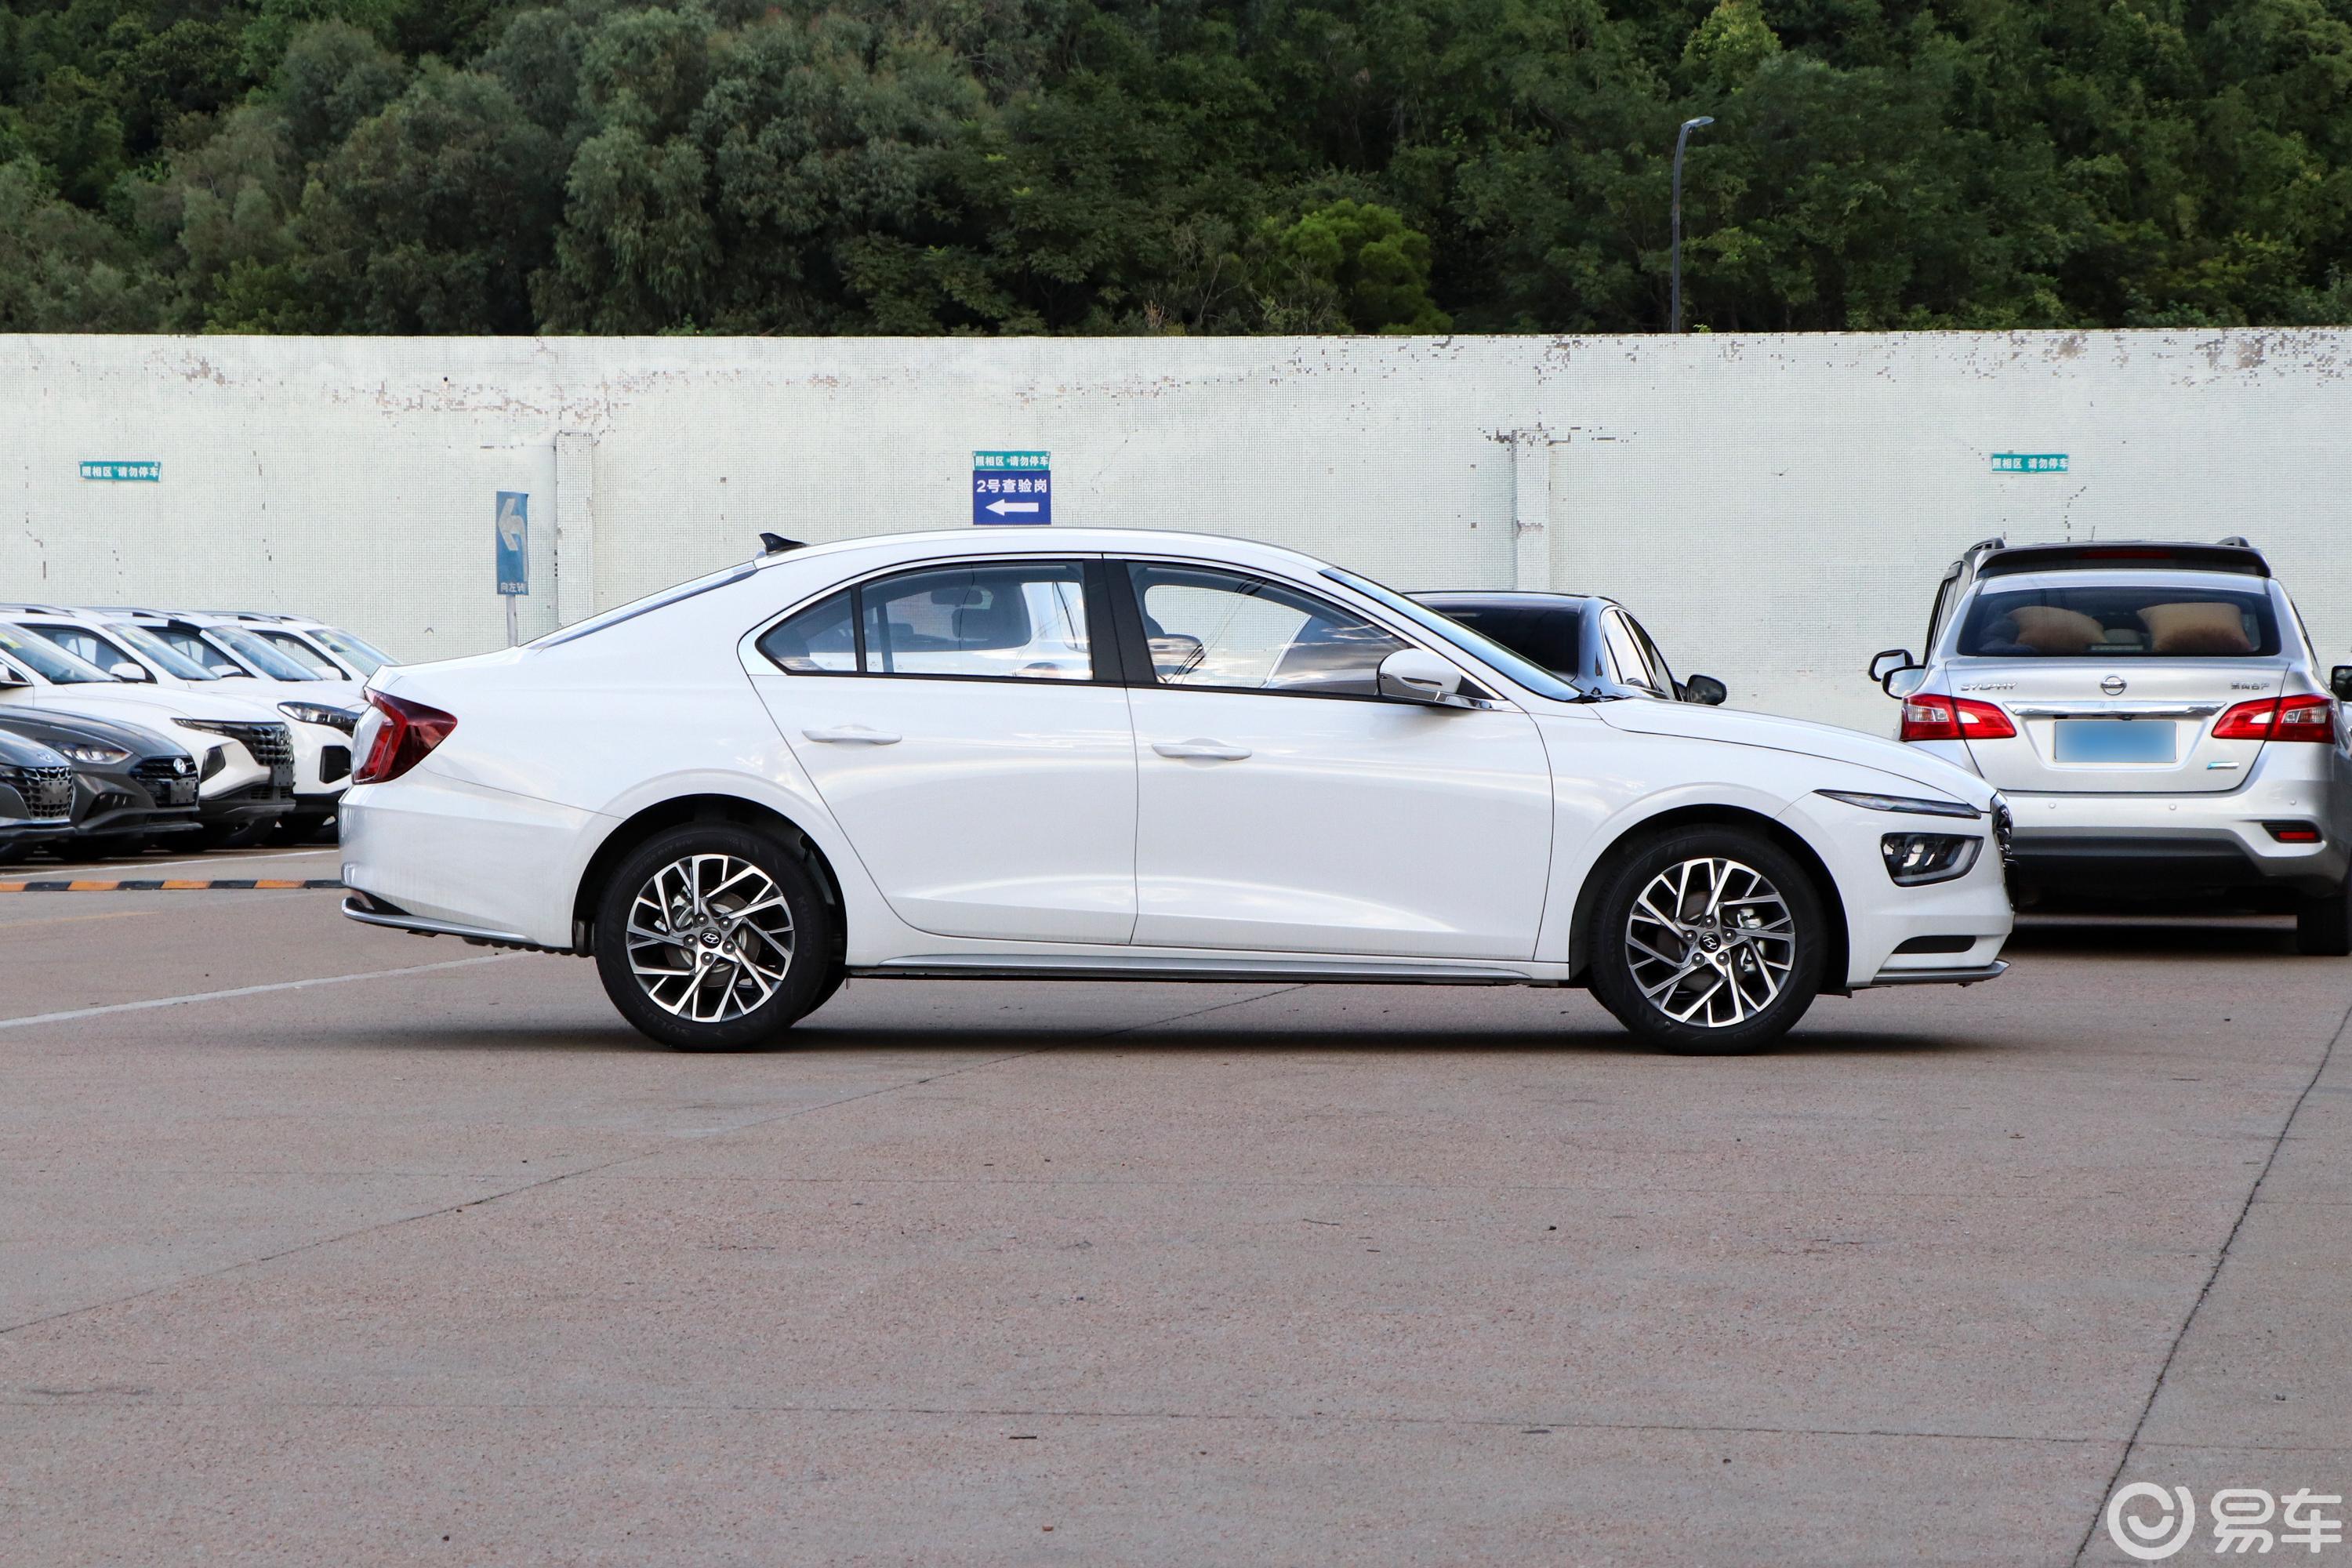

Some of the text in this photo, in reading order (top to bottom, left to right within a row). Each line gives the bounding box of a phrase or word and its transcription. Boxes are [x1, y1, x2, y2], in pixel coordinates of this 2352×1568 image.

[975, 456, 1049, 466] 照相区 请勿停车
[2028, 458, 2069, 469] 请勿停车
[82, 466, 159, 477] 照相区 请勿停车
[976, 478, 1047, 493] 2号查验岗
[1961, 681, 2018, 691] SYLPHY
